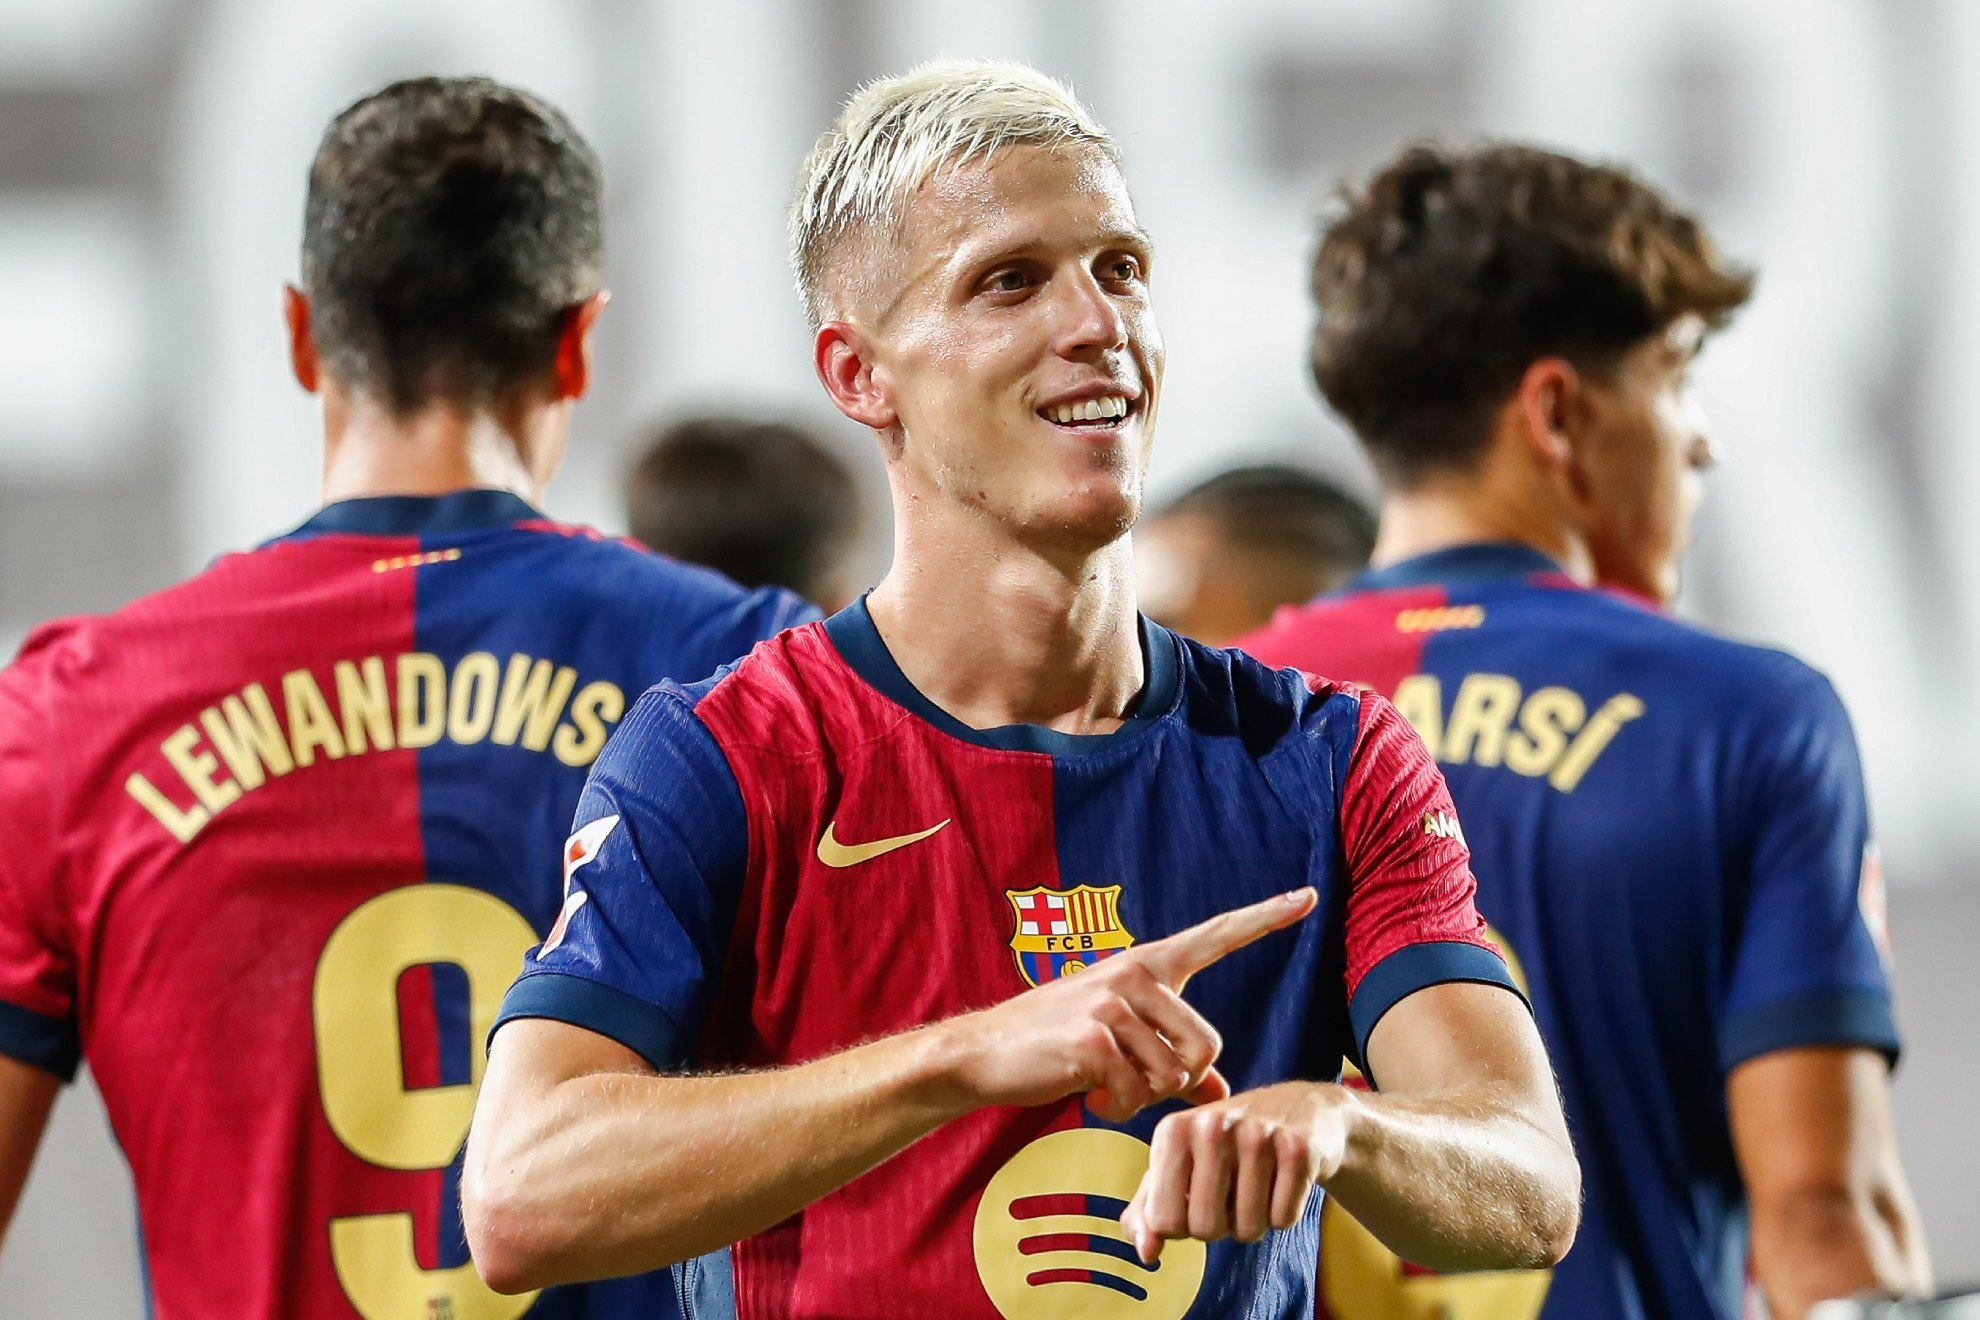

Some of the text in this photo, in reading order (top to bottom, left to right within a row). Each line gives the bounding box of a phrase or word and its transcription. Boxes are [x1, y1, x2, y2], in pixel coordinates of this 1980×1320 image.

[1356, 671, 1645, 793] ARSÍ
[1046, 935, 1094, 951] FCB
[313, 883, 546, 1320] 9
